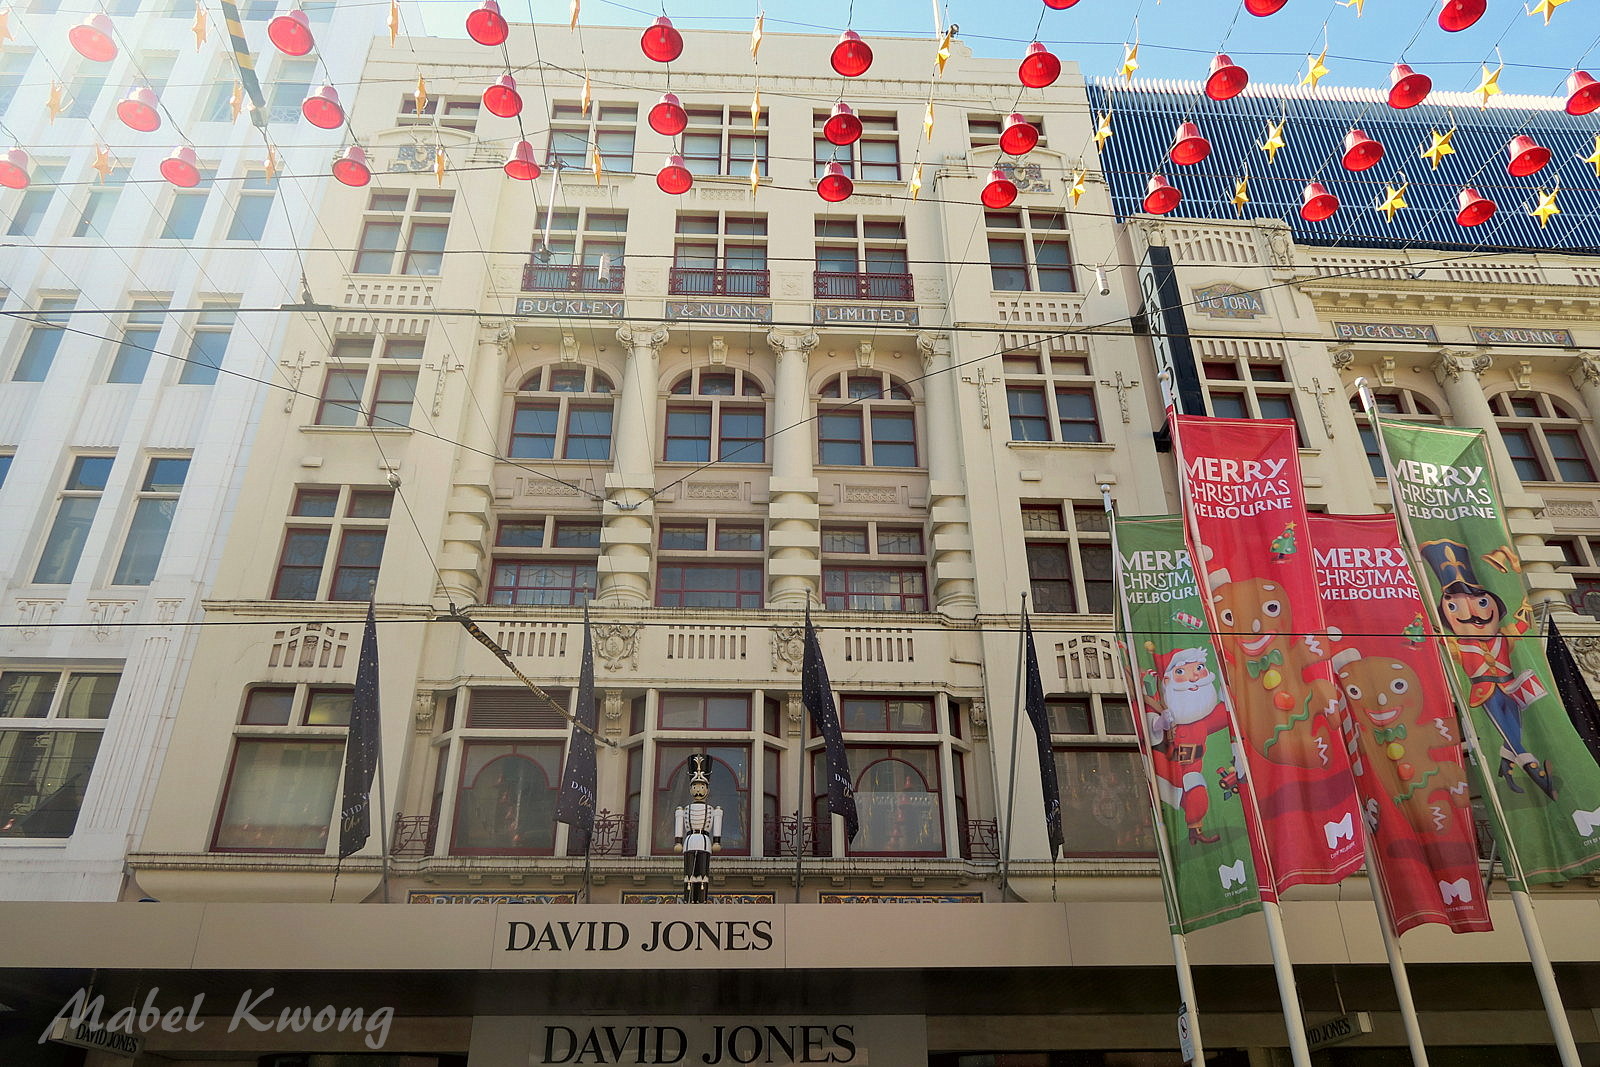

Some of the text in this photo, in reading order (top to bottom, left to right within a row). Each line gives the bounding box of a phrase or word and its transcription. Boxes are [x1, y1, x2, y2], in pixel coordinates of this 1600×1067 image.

[521, 300, 907, 322] BUCKLEY & NUNN LIMITED
[1196, 295, 1260, 310] VICTORIA
[1340, 324, 1557, 344] BUCKLEY & NUNN
[1184, 456, 1288, 483] MERRY
[1391, 459, 1483, 487] MERRY
[1400, 481, 1492, 507] HRISTMAS
[1404, 502, 1497, 521] ELBOURNE
[1119, 549, 1193, 571] MERR
[1313, 547, 1408, 568] MERRY
[1121, 570, 1196, 591] CHRISTM
[1126, 585, 1200, 604] MELBOUR
[1320, 587, 1420, 601] MELBOURNE
[505, 920, 773, 952] DAVID JONES
[76, 1023, 138, 1054] DAVID JONES
[1321, 1017, 1351, 1041] JONES
[541, 1024, 857, 1065] DAVID JONES
